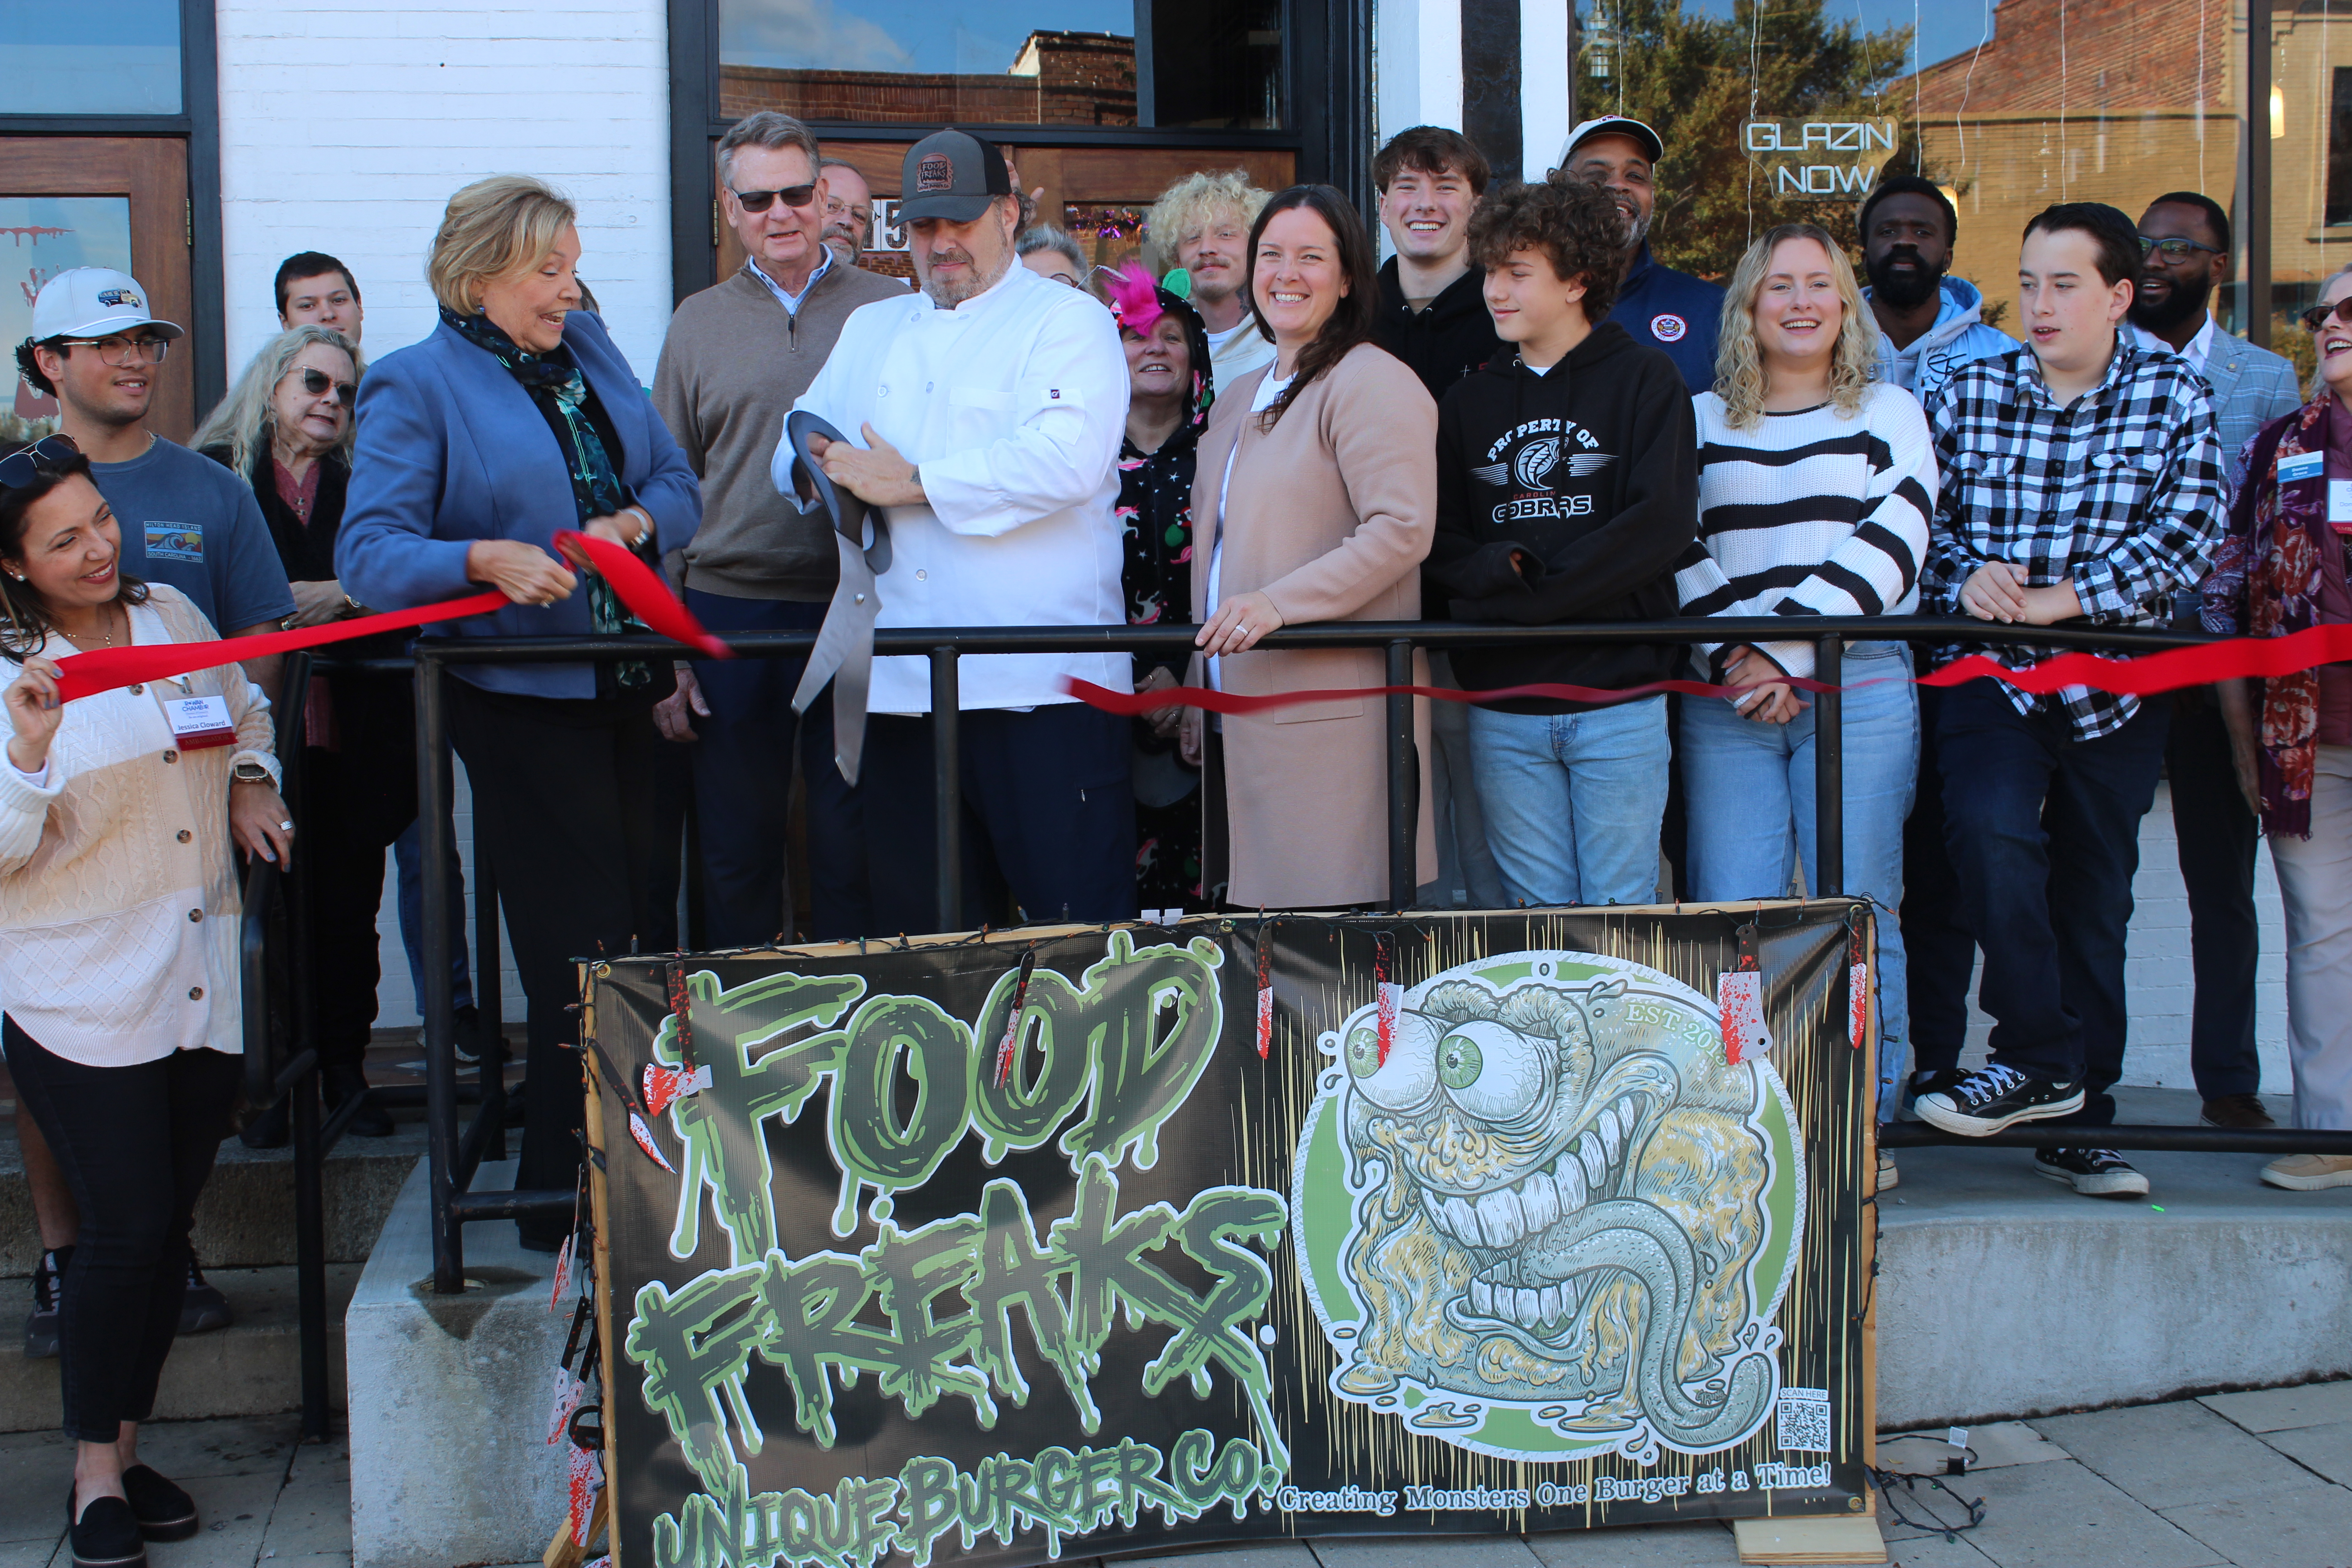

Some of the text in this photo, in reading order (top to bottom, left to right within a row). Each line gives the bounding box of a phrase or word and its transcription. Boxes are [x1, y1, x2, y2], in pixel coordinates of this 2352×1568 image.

[1747, 122, 1892, 151] GLAZIN
[921, 169, 946, 179] FREAKS
[922, 162, 946, 172] FOOD
[1778, 165, 1875, 193] NOW
[1576, 429, 1599, 449] OF
[1514, 491, 1563, 500] CAROLIN
[200, 720, 226, 728] Cloward
[185, 734, 230, 745] AMBASSADOR
[1626, 1004, 1681, 1030] EST.
[653, 929, 1224, 1270] FOOD
[627, 1152, 1289, 1497] FREAKS
[1806, 1390, 1827, 1399] HERE
[1279, 1462, 1831, 1515] Creating Monsters One Burger at a Time!
[652, 1462, 902, 1568] UNIQUE
[894, 1436, 1203, 1568] BURGER
